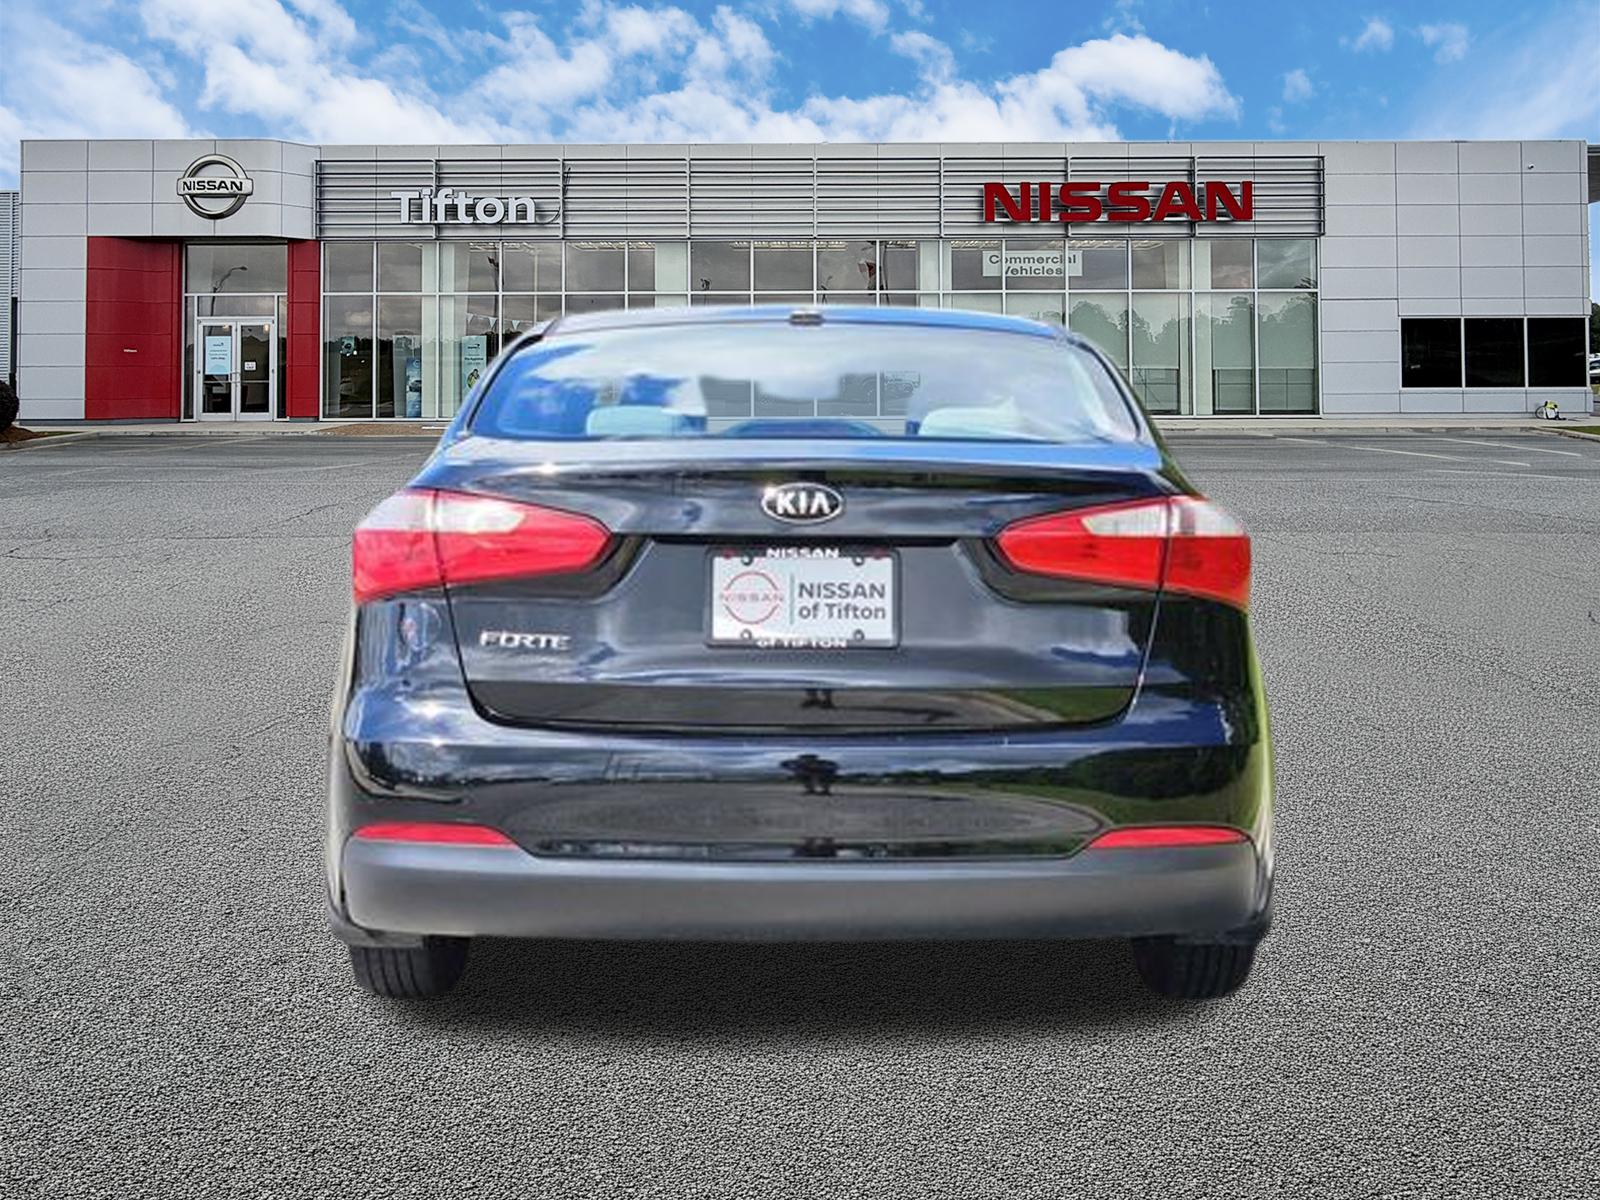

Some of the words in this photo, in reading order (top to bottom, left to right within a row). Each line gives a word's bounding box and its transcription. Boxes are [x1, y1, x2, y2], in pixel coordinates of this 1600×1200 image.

[182, 179, 243, 192] NISSAN
[391, 188, 536, 224] Tifton
[983, 181, 1253, 222] NISSAN
[777, 491, 831, 514] KIA
[766, 548, 840, 559] NISSAN
[799, 583, 886, 599] NISSAN
[799, 604, 821, 620] of
[824, 604, 886, 620] Tifton
[480, 631, 571, 650] FORTE
